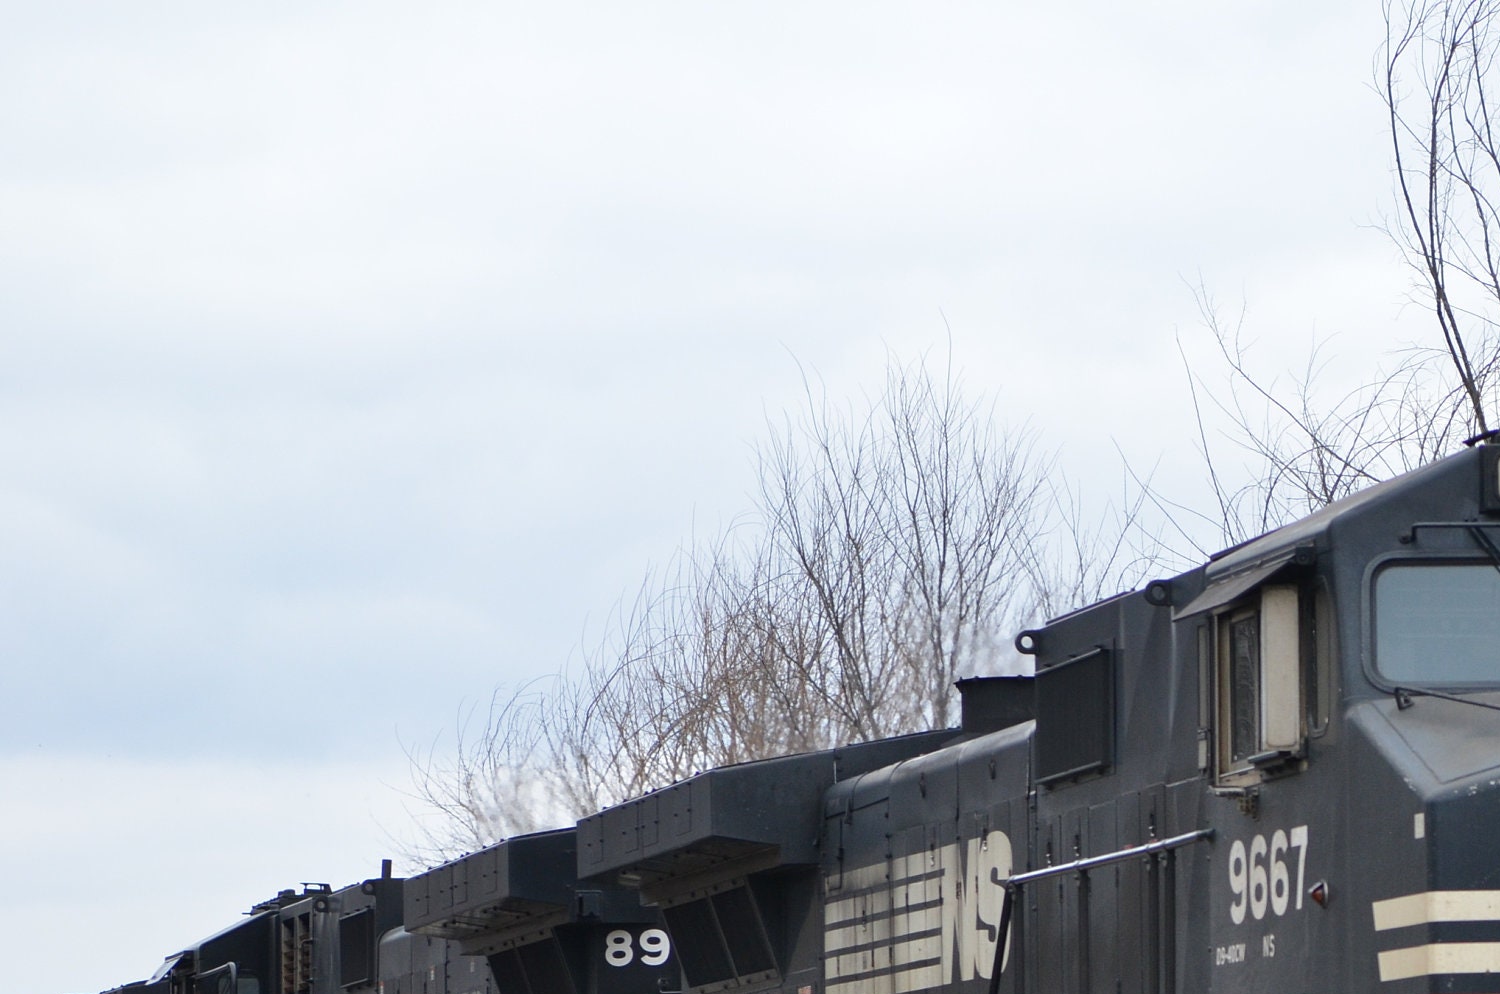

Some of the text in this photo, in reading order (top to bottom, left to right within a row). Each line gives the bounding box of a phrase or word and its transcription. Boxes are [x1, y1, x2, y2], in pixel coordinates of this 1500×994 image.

[941, 830, 1014, 983] NS
[1228, 824, 1309, 925] 9667
[604, 928, 671, 967] 89
[1262, 934, 1275, 958] NS
